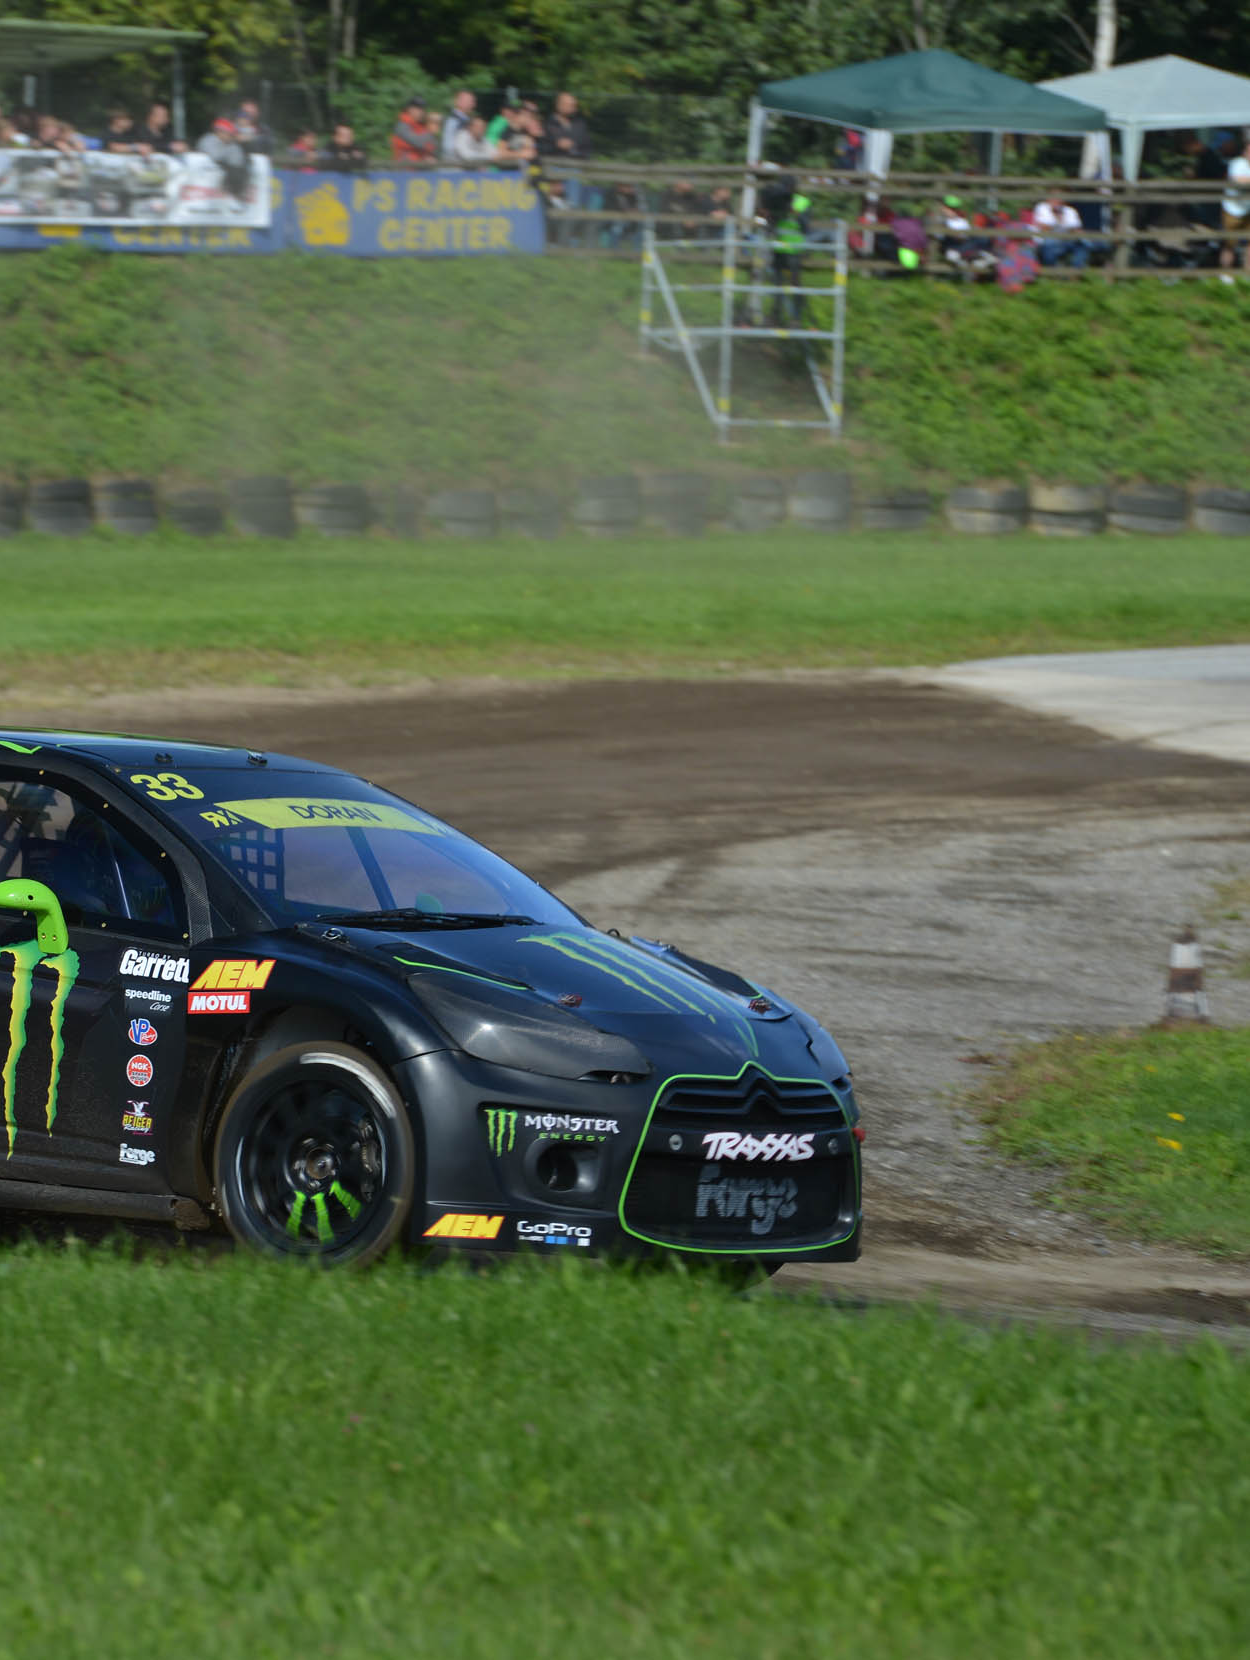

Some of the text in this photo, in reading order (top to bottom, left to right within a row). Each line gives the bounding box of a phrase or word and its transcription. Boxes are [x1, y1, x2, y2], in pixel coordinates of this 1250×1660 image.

[353, 177, 537, 212] PS RACING
[378, 215, 511, 250] CENTER
[130, 772, 205, 801] 33
[287, 804, 383, 822] DORAN
[119, 948, 190, 984] Garrett
[189, 959, 277, 990] AEM
[125, 988, 172, 1003] speedline
[190, 995, 248, 1011] MOTUL
[130, 1018, 151, 1045] VP
[131, 1062, 149, 1070] NGK
[122, 1114, 153, 1129] REIGER
[524, 1113, 621, 1134] MONSTER
[538, 1132, 607, 1143] ENERGY
[701, 1132, 815, 1161] TRAXXAS
[422, 1213, 505, 1240] AEM
[516, 1220, 593, 1238] GoPro
